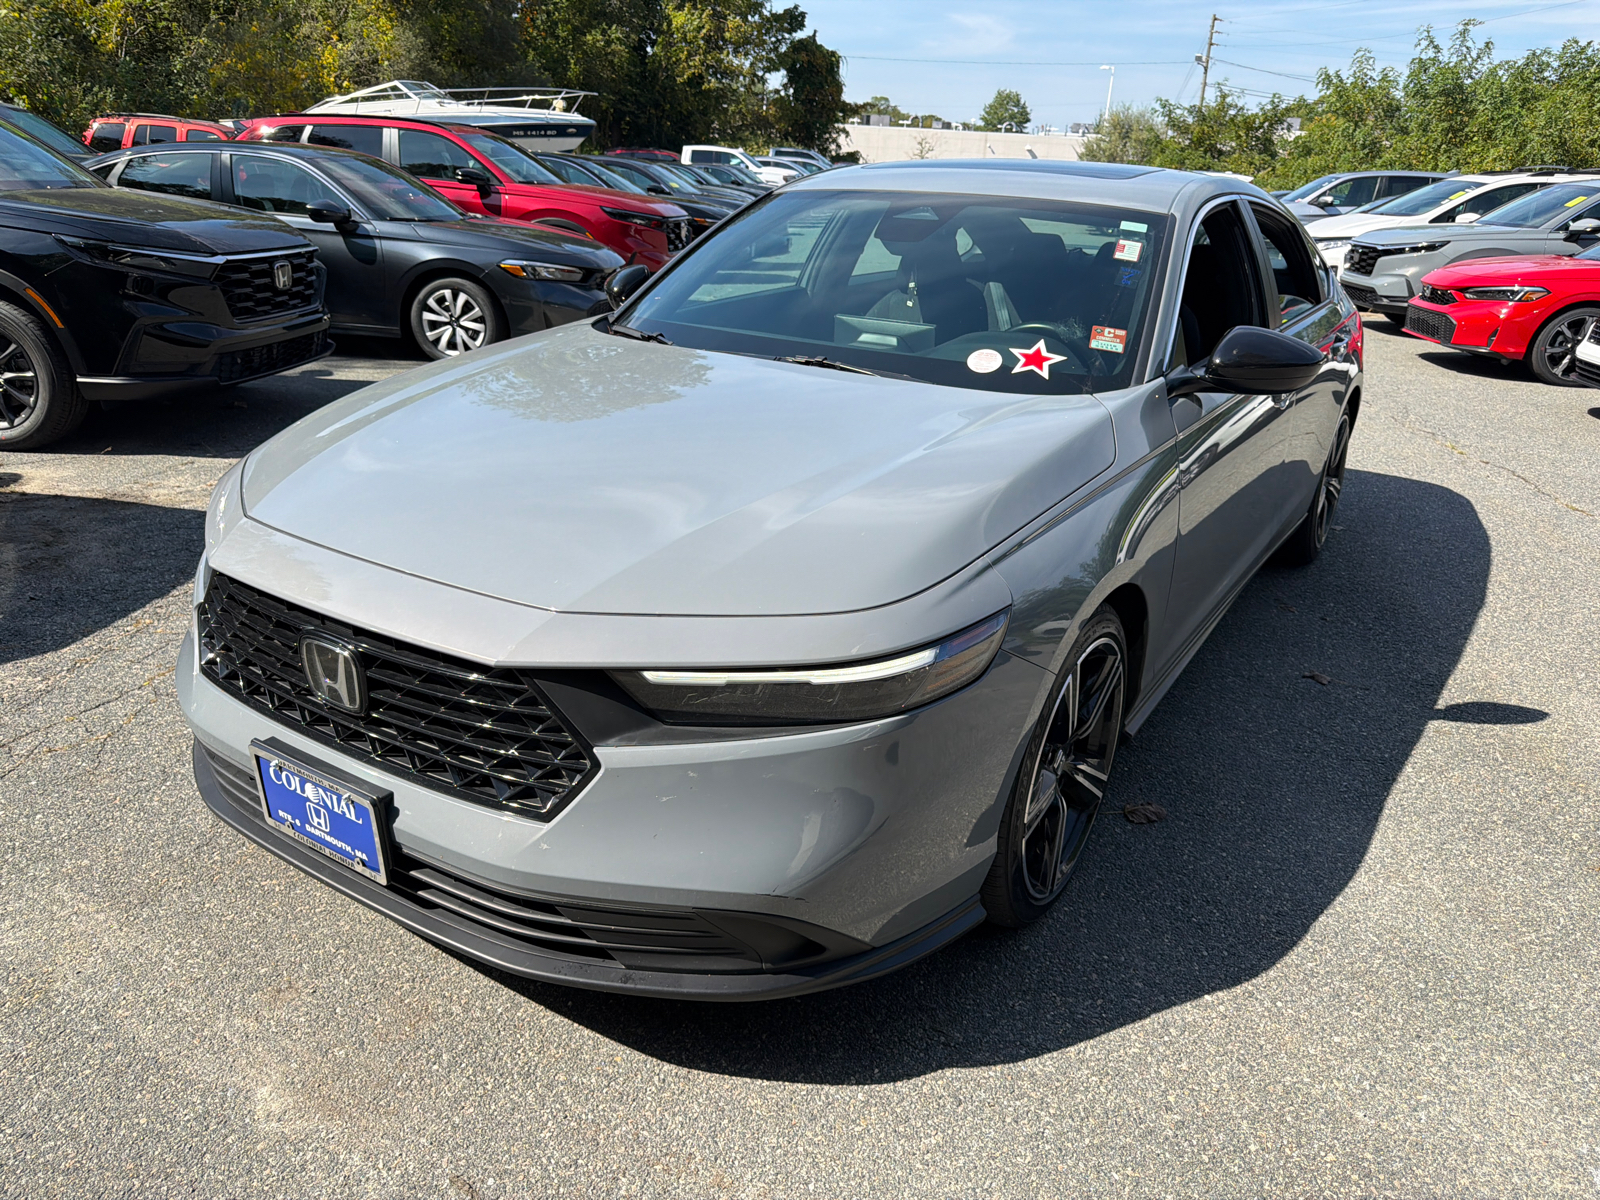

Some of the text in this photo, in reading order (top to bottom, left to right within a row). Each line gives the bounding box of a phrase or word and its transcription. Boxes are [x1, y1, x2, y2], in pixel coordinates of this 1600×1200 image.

[1104, 328, 1115, 338] C
[305, 823, 369, 862] DARTMOUTH, MA
